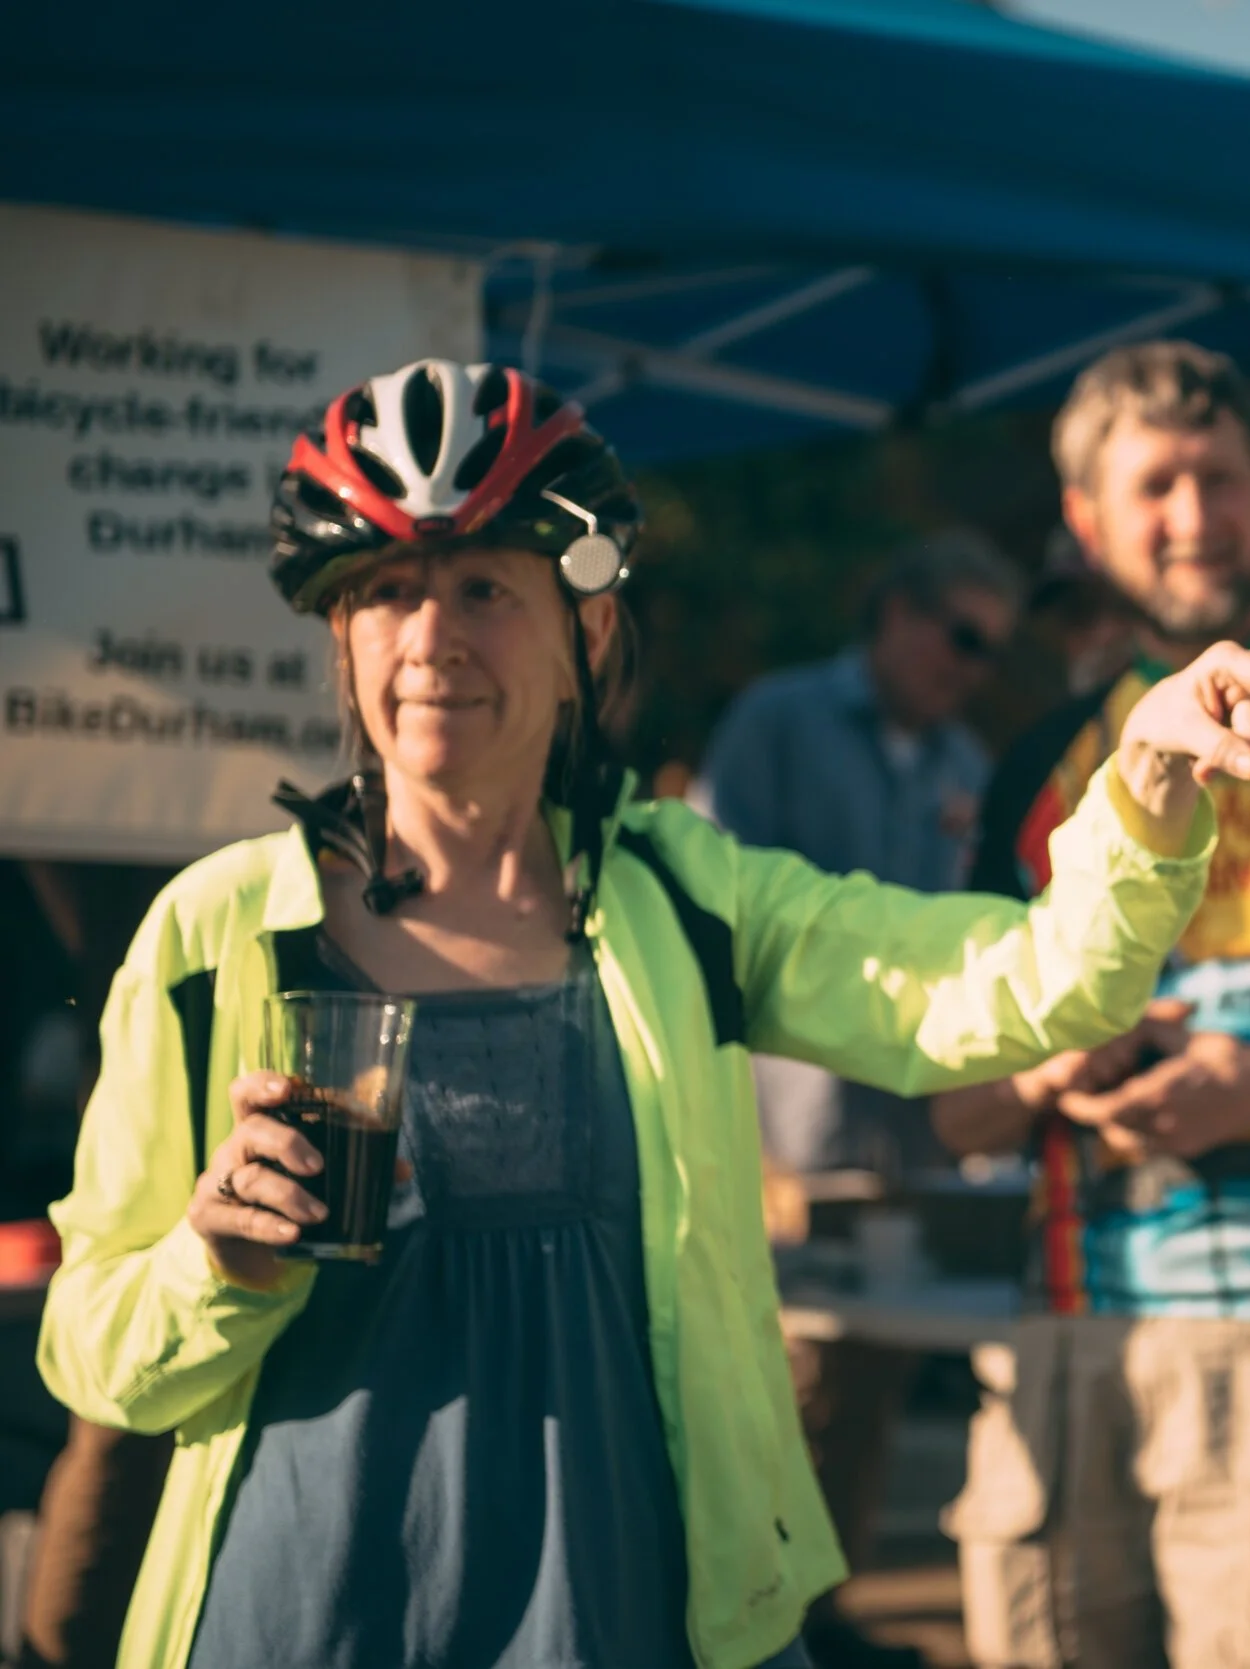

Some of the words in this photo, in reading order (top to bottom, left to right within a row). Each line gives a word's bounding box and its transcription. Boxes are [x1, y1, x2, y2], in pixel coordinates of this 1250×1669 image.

[40, 321, 239, 386] Working
[255, 339, 317, 382] for
[66, 447, 249, 504] change
[90, 629, 184, 676] Join
[195, 646, 253, 687] us
[266, 648, 308, 690] at
[5, 688, 343, 746] BikeDurham.or
